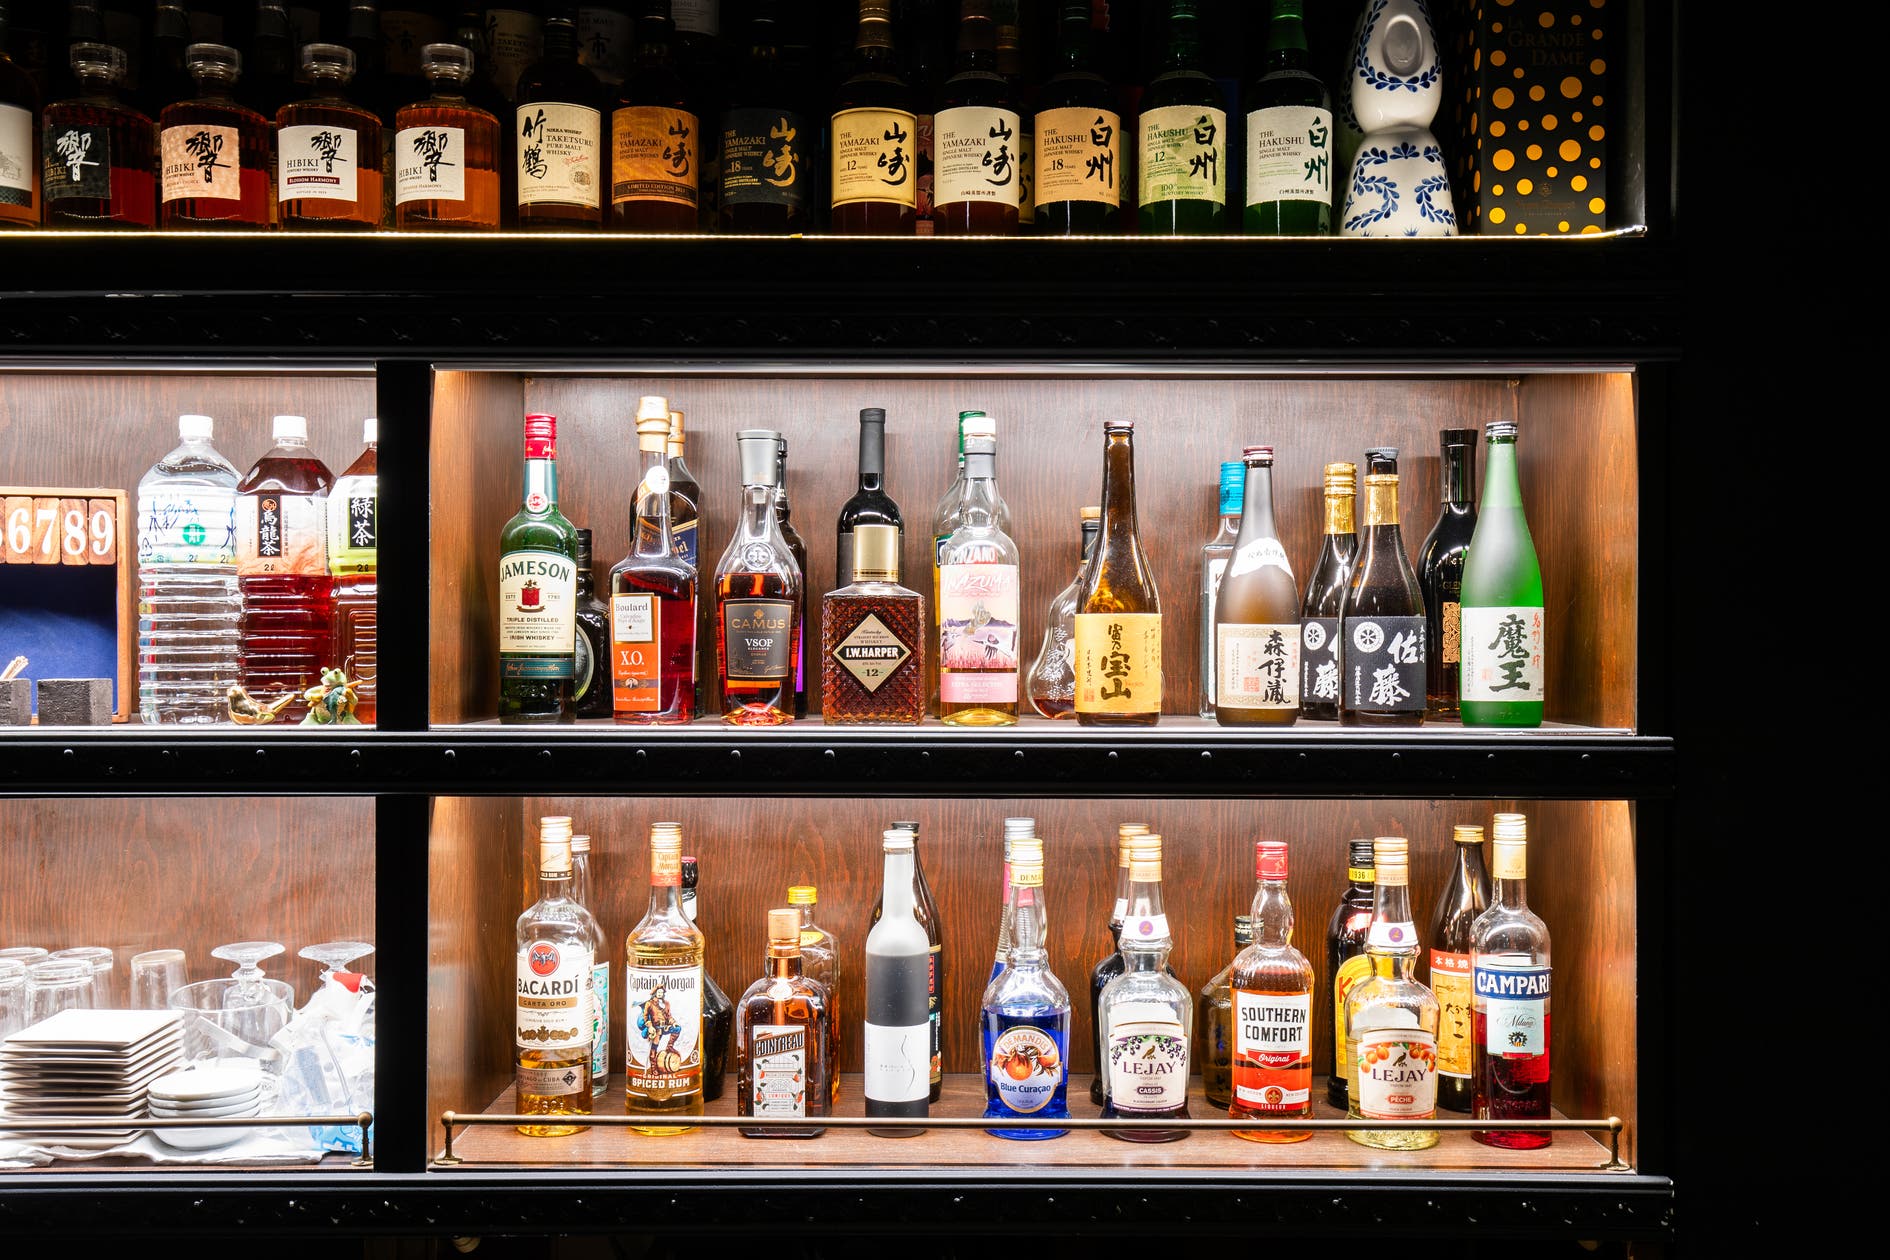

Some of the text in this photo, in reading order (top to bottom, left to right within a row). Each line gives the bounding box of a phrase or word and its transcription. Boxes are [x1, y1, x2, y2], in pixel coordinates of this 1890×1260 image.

[1507, 31, 1585, 47] GRANDE
[1531, 49, 1585, 66] DAME
[1044, 128, 1058, 137] THE
[1147, 123, 1160, 132] THE
[1260, 130, 1274, 138] THE
[619, 131, 632, 140] THE
[840, 131, 852, 140] THE
[942, 131, 956, 140] THE
[1044, 134, 1088, 146] HAKUSHU
[1147, 128, 1189, 141] HAKUSHU
[522, 108, 548, 180] 竹鶴
[545, 135, 594, 148] TAKETSURU
[619, 138, 663, 148] YAMAZAKI
[662, 118, 692, 178] 山崎
[725, 136, 766, 148] YAMAZAKI
[839, 137, 880, 149] YAMAZAKI
[942, 137, 987, 149] YAMAZAKI
[1259, 136, 1305, 148] HAKUSHU
[56, 130, 100, 182] 響
[185, 130, 232, 184] 響
[311, 130, 347, 174] 響
[413, 130, 456, 183] 響
[763, 117, 799, 187] 山崎
[877, 121, 910, 186] 山崎
[981, 118, 1015, 186] 山崎
[1085, 115, 1114, 189] 白州
[1154, 151, 1166, 162] 12
[1188, 115, 1217, 186] 白州
[1304, 115, 1329, 191] 白州
[165, 163, 195, 176] HIBIKI
[286, 158, 319, 168] HIBIKI
[731, 160, 742, 173] 18
[846, 160, 857, 171] 12
[1051, 158, 1064, 171] 18
[399, 166, 423, 178] HIBIKI
[310, 176, 338, 184] HARMONY
[651, 183, 674, 191] EDITION
[350, 497, 375, 547] 緑茶
[500, 560, 570, 583] JAMESON
[615, 602, 648, 612] Boulard
[731, 618, 786, 629] CAMUS
[744, 638, 774, 648] VSOP
[620, 650, 645, 666] X.O.
[1487, 613, 1531, 693] 魔王
[866, 668, 880, 677] 12
[1369, 629, 1419, 707] 佐藤
[1435, 956, 1469, 969] 本格焼
[517, 974, 579, 996] BACARDÍ
[629, 973, 696, 992] Captain Morgan
[1476, 971, 1550, 996] CAMPARI
[1241, 1007, 1307, 1024] SOUTHERN
[1245, 1024, 1303, 1042] COMFORT
[755, 1033, 804, 1056] COINTREAU
[1258, 1053, 1290, 1064] Original
[1122, 1060, 1177, 1075] LEJAY
[1372, 1068, 1428, 1083] LEJAY
[632, 1077, 691, 1089] SPICED RUM
[1000, 1082, 1051, 1094] Blue Curaçao
